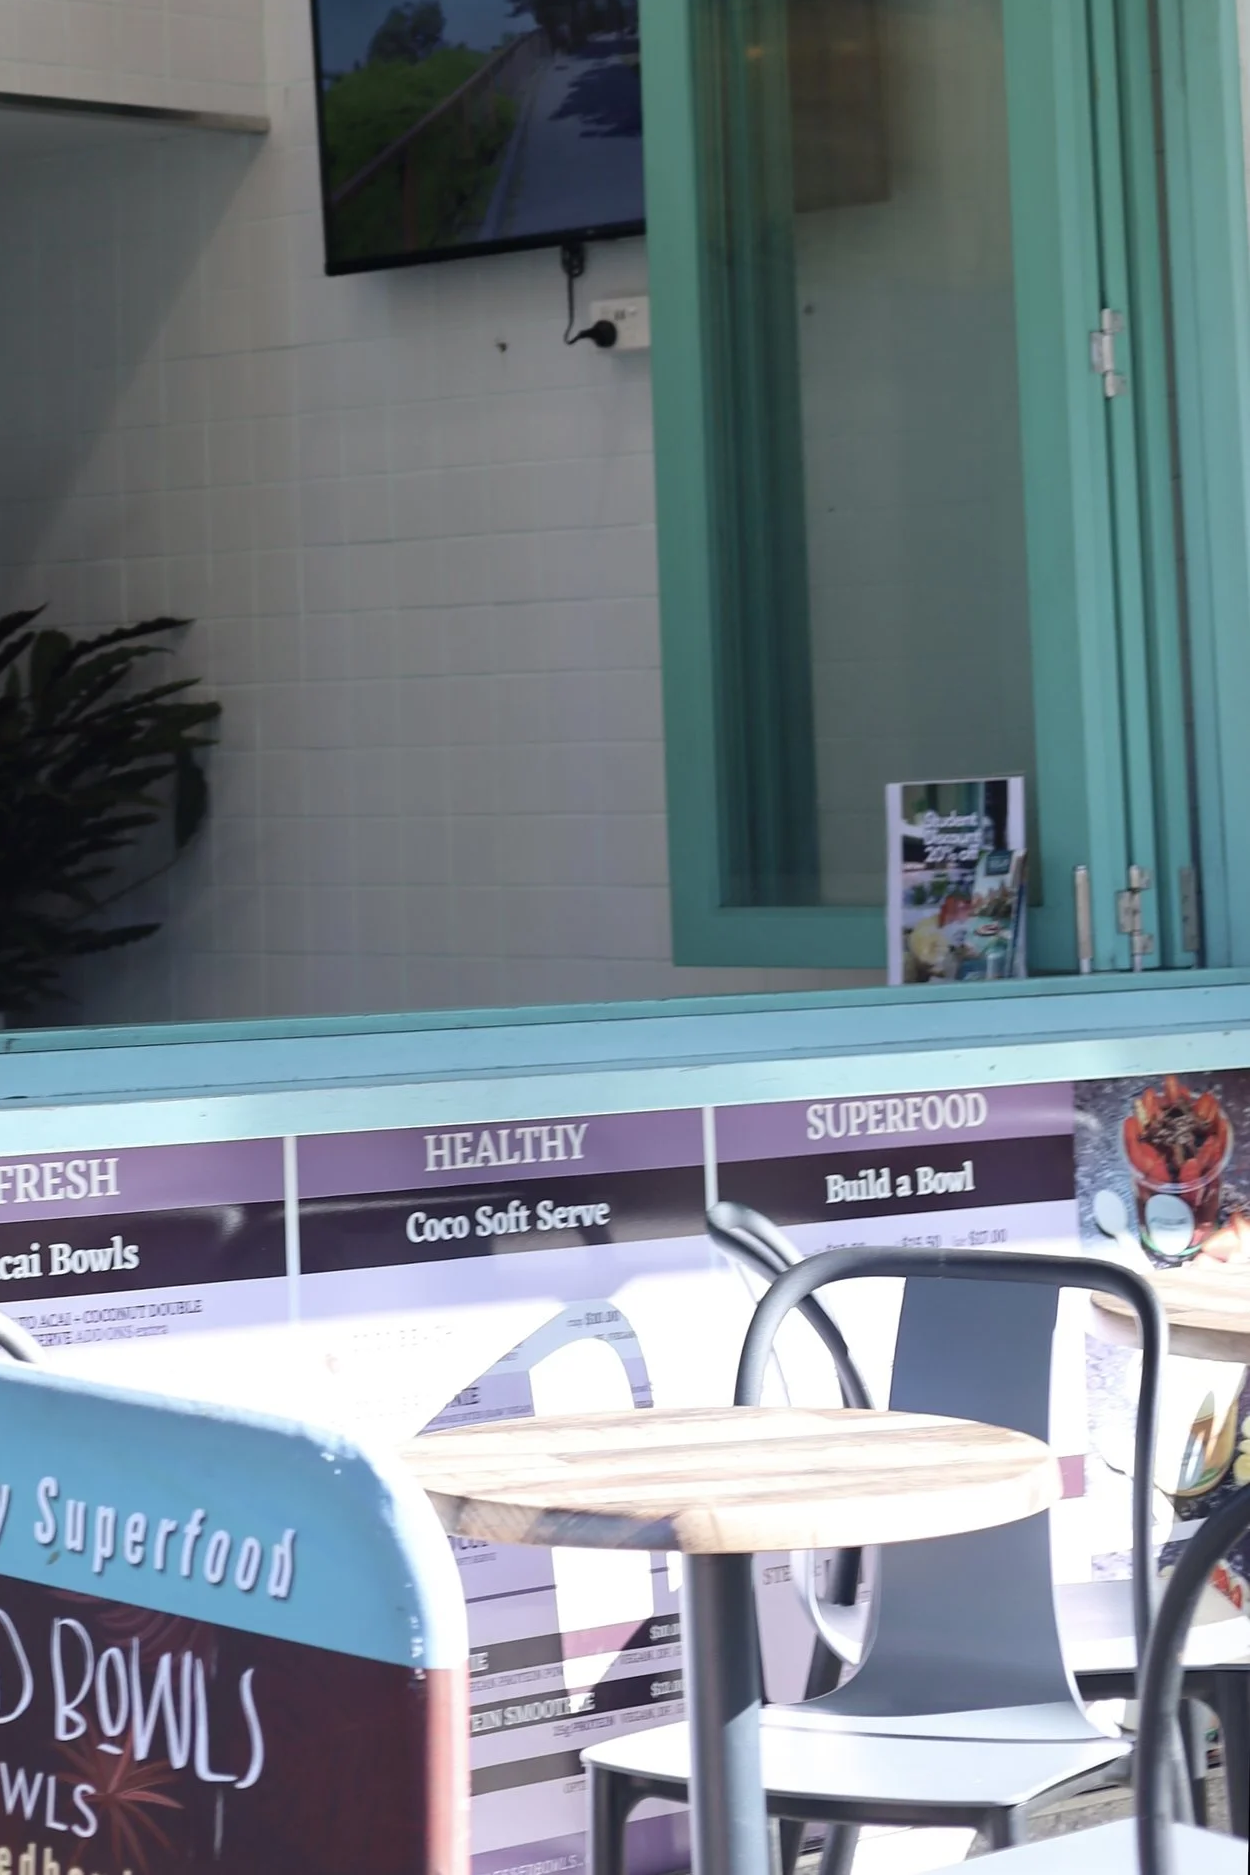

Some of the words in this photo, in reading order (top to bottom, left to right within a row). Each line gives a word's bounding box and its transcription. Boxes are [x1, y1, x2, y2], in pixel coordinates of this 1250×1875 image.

[806, 1093, 988, 1141] SUPERFOOD
[423, 1123, 589, 1172] HEALTHY
[826, 1165, 889, 1205] Build
[895, 1174, 912, 1198] a
[915, 1161, 976, 1197] Bowl
[406, 1206, 470, 1244] Coco
[475, 1200, 528, 1239] Soft
[532, 1198, 611, 1233] Serve
[50, 1234, 140, 1276] Bowls
[84, 1304, 147, 1324] COCONUT
[149, 1299, 203, 1318] DOUBLE
[36, 1475, 296, 1601] Superfood
[54, 1617, 264, 1790] BOWLS
[504, 1691, 596, 1725] SMOOTE
